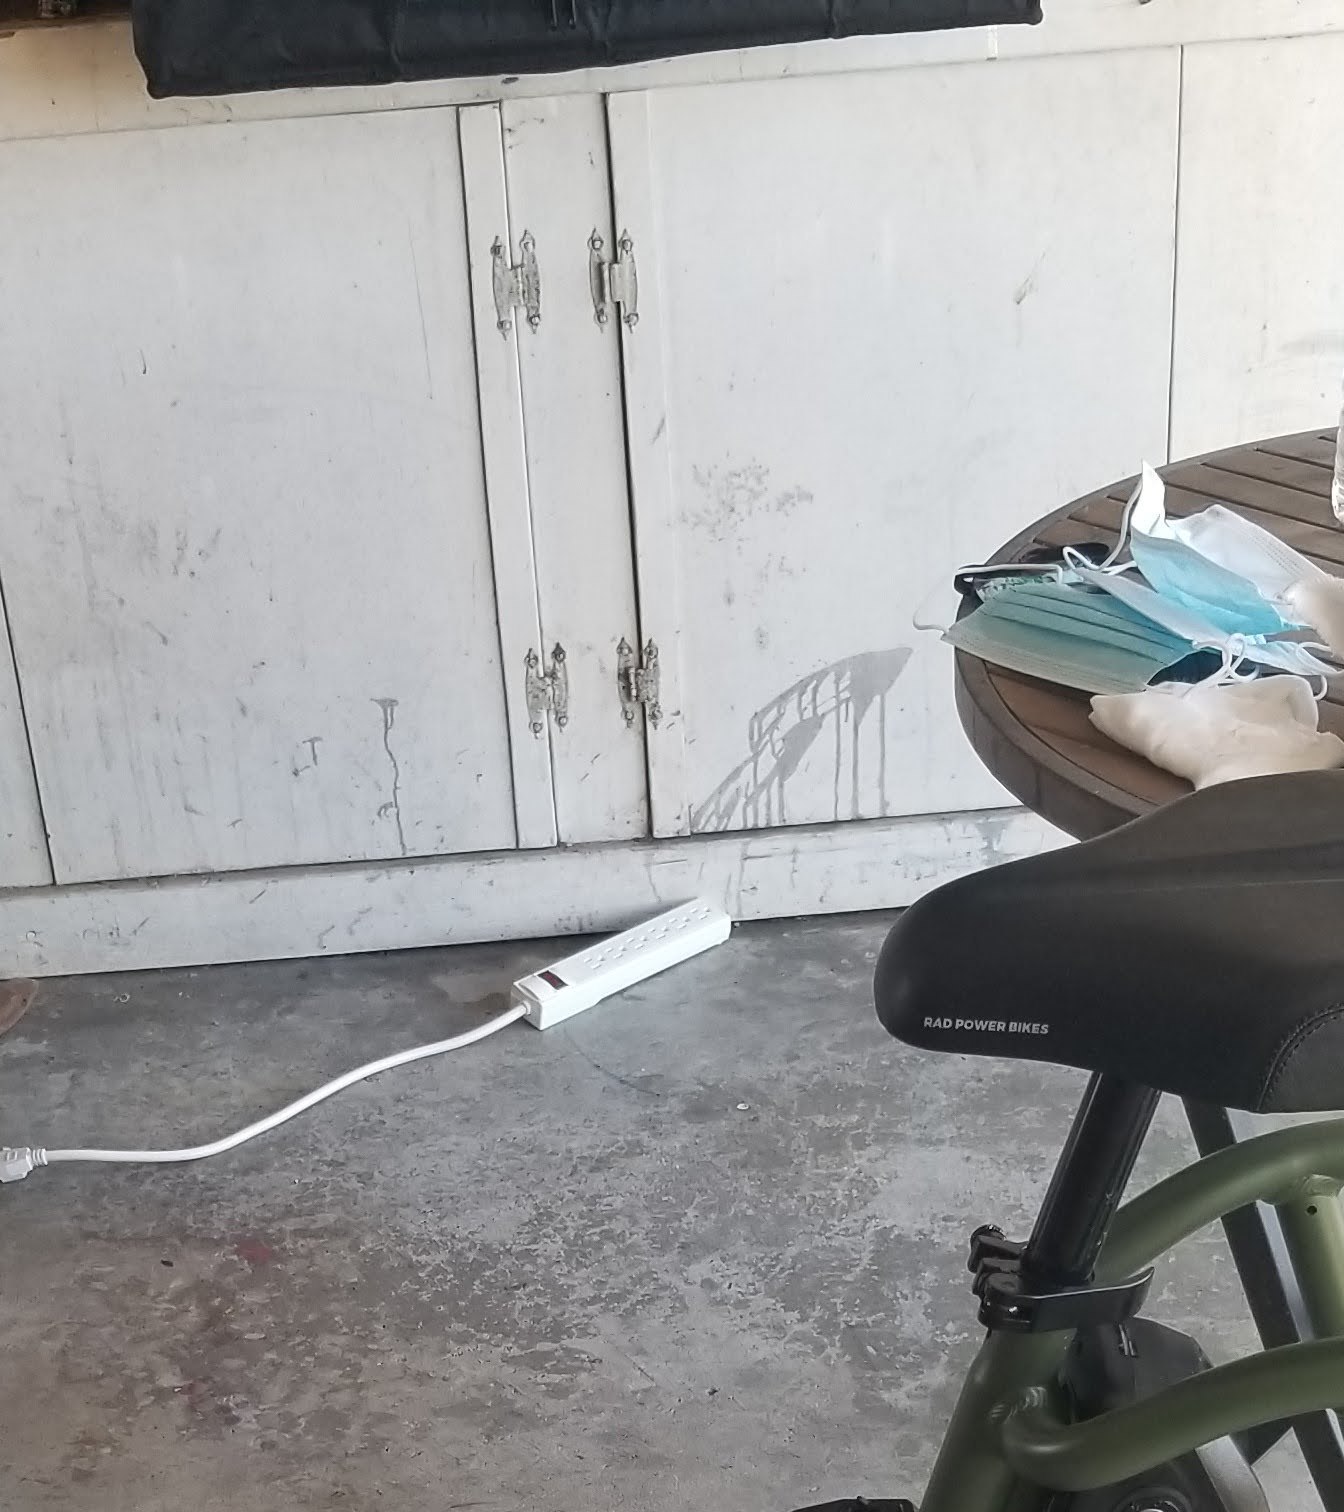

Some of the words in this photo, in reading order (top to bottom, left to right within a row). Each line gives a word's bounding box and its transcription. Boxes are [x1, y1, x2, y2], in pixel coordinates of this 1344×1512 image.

[923, 1016, 953, 1029] RAD
[954, 1018, 1007, 1032] POWER
[1008, 1021, 1049, 1035] BIKES
